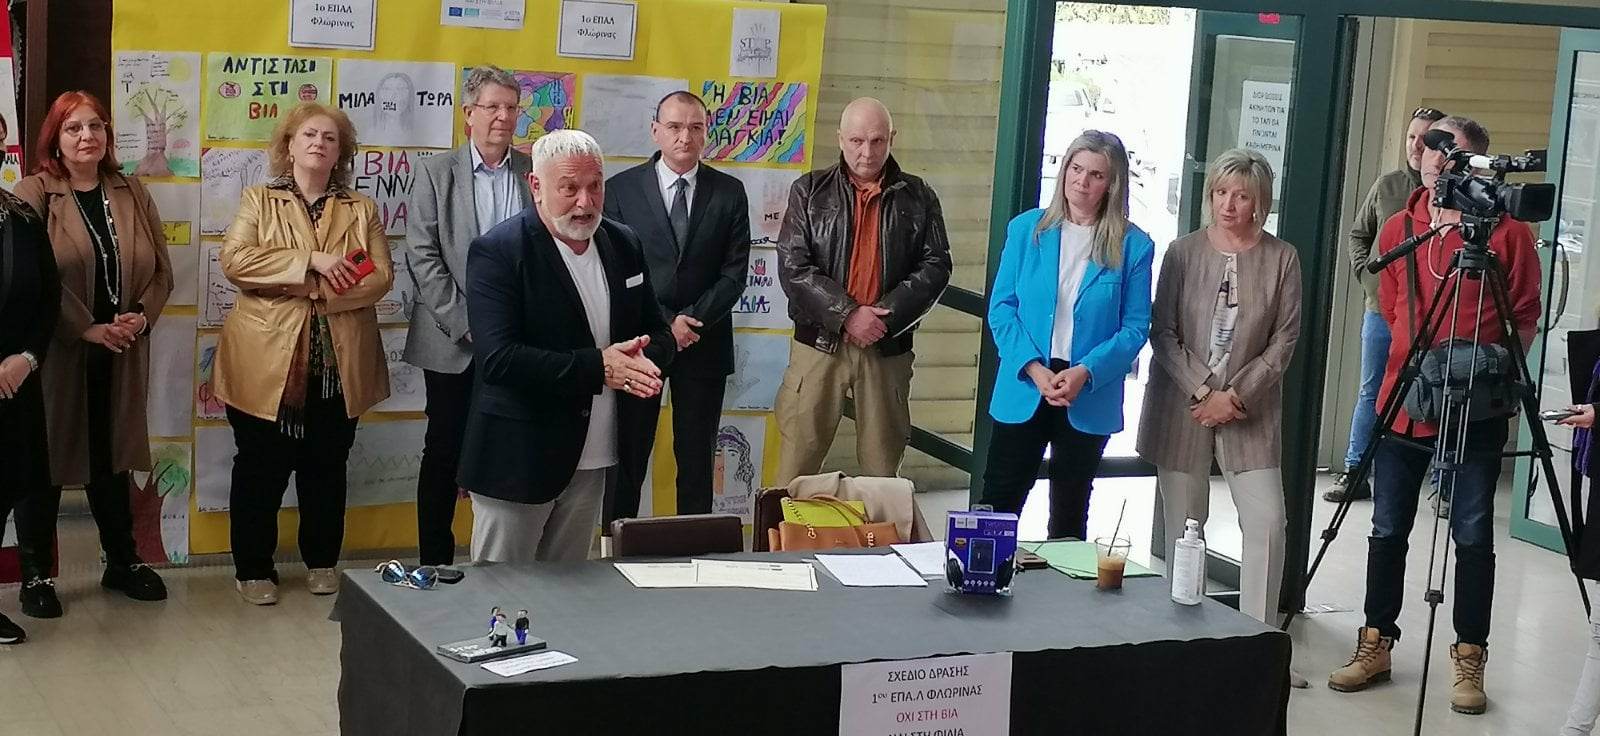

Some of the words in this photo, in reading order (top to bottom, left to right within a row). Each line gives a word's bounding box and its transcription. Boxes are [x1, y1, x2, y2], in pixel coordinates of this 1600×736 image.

[338, 92, 376, 109] ΜΙΛΑ
[416, 91, 453, 107] ΤΩΡΑ
[713, 84, 726, 103] Η
[738, 85, 769, 105] ΒΙΑ
[249, 102, 278, 119] ΒΙΑ
[365, 150, 410, 176] ΒΙΑ
[887, 668, 926, 682] ΣΧΕΔΙΟ
[929, 665, 969, 679] ΔΡΑΣΗΣ
[926, 684, 983, 700] ΦΛΩΡΙΝΑΣ
[896, 711, 915, 723] ΟΧΙ
[917, 709, 938, 721] ΣΤΗ
[941, 708, 959, 720] ΒΙΑ
